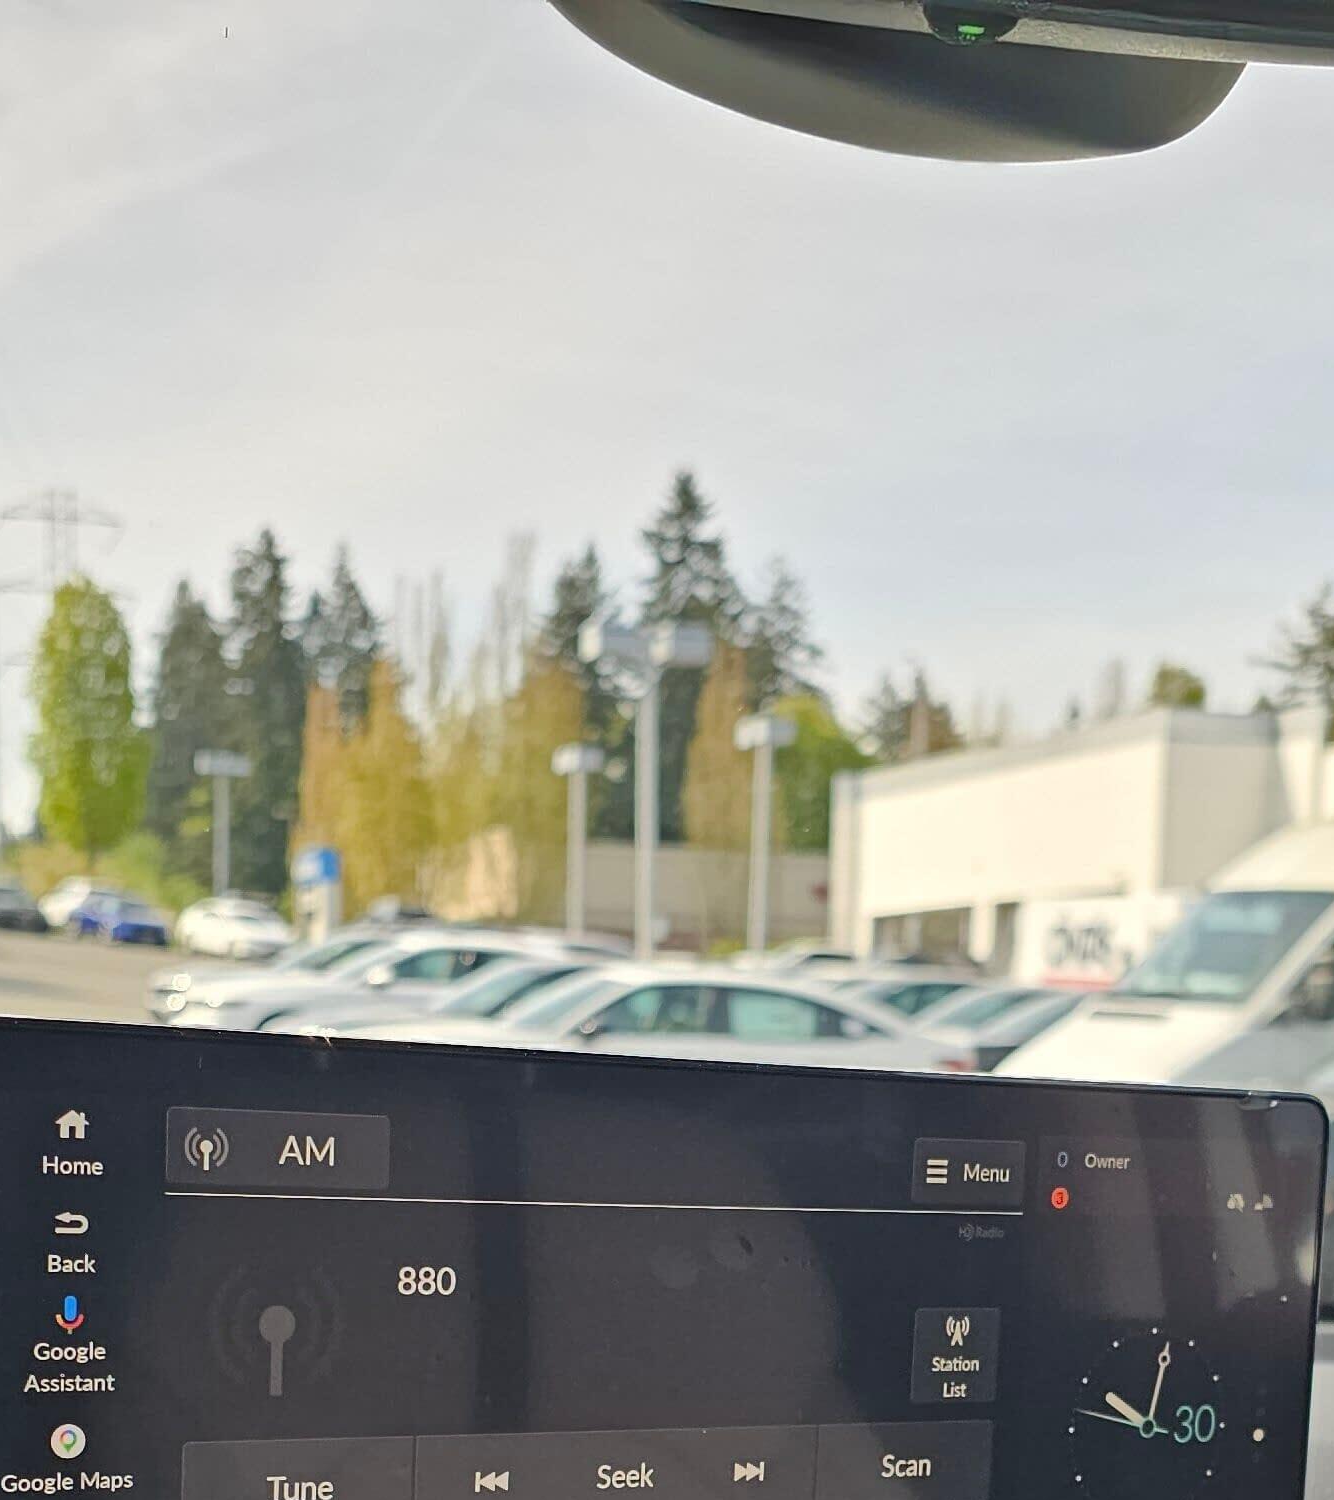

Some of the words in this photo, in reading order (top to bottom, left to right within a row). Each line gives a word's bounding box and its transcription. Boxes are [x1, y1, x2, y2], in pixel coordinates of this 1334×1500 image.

[278, 1135, 335, 1167] AM
[1084, 1153, 1131, 1170] Owner
[42, 1155, 104, 1176] Home
[963, 1163, 1010, 1183] Menu
[47, 1253, 96, 1274] Back
[397, 1266, 457, 1296] 880
[33, 1340, 107, 1364] Google
[931, 1355, 980, 1372] Station
[23, 1373, 116, 1393] Assistant
[942, 1381, 967, 1398] List
[1173, 1404, 1216, 1444] 30
[596, 1462, 654, 1490] Seek
[881, 1454, 932, 1478] Scan
[0, 1471, 74, 1495] Google
[80, 1471, 134, 1493] Maps
